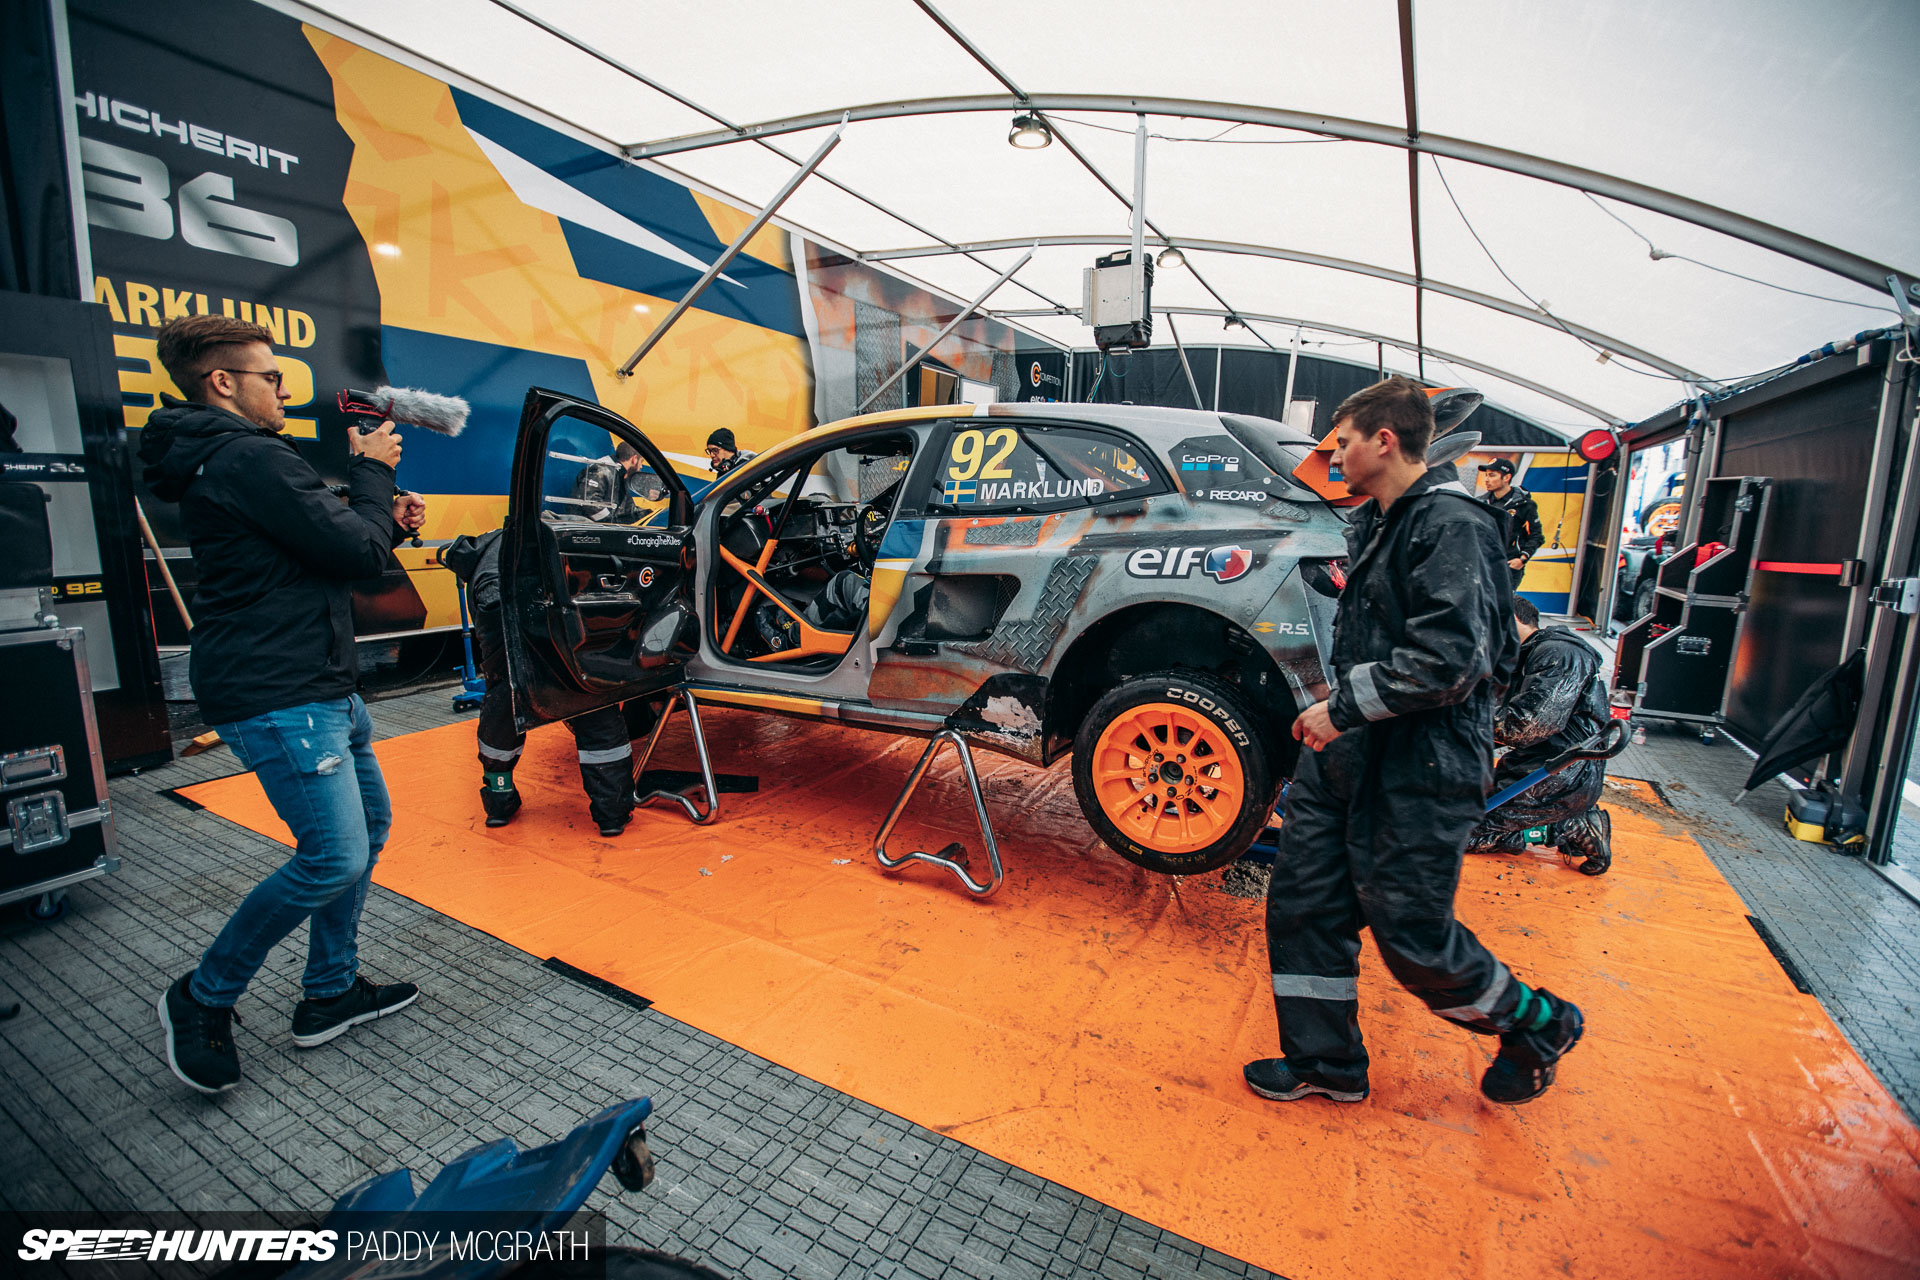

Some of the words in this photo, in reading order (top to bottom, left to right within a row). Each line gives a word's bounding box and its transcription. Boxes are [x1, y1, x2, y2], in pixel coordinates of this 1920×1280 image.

[79, 136, 300, 267] 36
[949, 428, 1019, 481] 92
[1182, 454, 1239, 464] GoPro
[50, 462, 85, 473] 36
[980, 477, 1104, 501] MARKLUND
[1209, 490, 1267, 502] RECARO
[1128, 547, 1206, 576] elf
[66, 582, 103, 595] 92
[1279, 622, 1310, 636] R.S.
[1166, 687, 1250, 747] COOPER
[497, 776, 505, 787] 8
